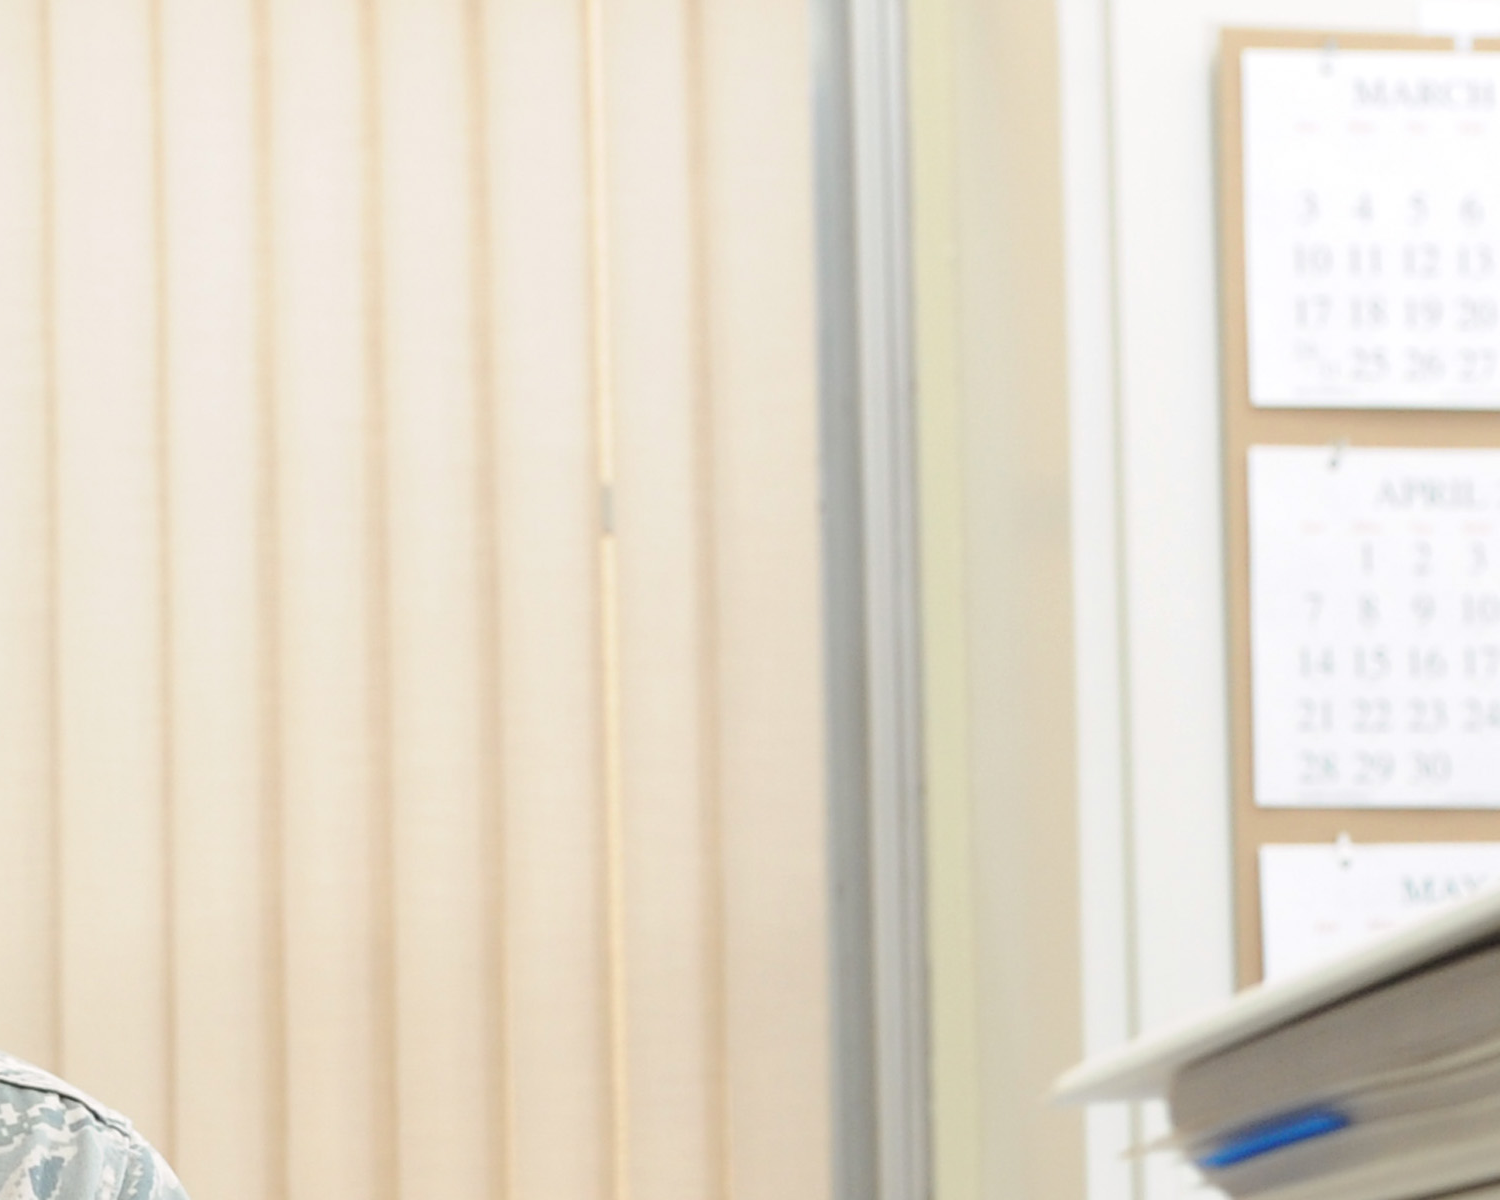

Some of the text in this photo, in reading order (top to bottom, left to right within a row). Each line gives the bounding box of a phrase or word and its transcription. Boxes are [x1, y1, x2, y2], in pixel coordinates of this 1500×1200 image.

[1352, 77, 1496, 110] MARCH
[1298, 189, 1320, 226] 3
[1351, 190, 1374, 225] 4
[1292, 241, 1496, 281] 10 11 12 13
[1294, 293, 1333, 330] 17
[1348, 292, 1390, 331] 18
[1403, 294, 1445, 333] 19
[1348, 345, 1391, 384] 25
[1456, 345, 1498, 384] 27
[1374, 476, 1488, 511] APRIL
[1360, 540, 1488, 578] 1 2 3
[1303, 590, 1500, 629] 7 8 9 10
[1298, 643, 1500, 682] 14 15 16 17
[1296, 696, 1334, 734] 21
[1351, 696, 1393, 734] 22
[1406, 696, 1450, 734] 23
[1297, 748, 1453, 786] 28 29 30
